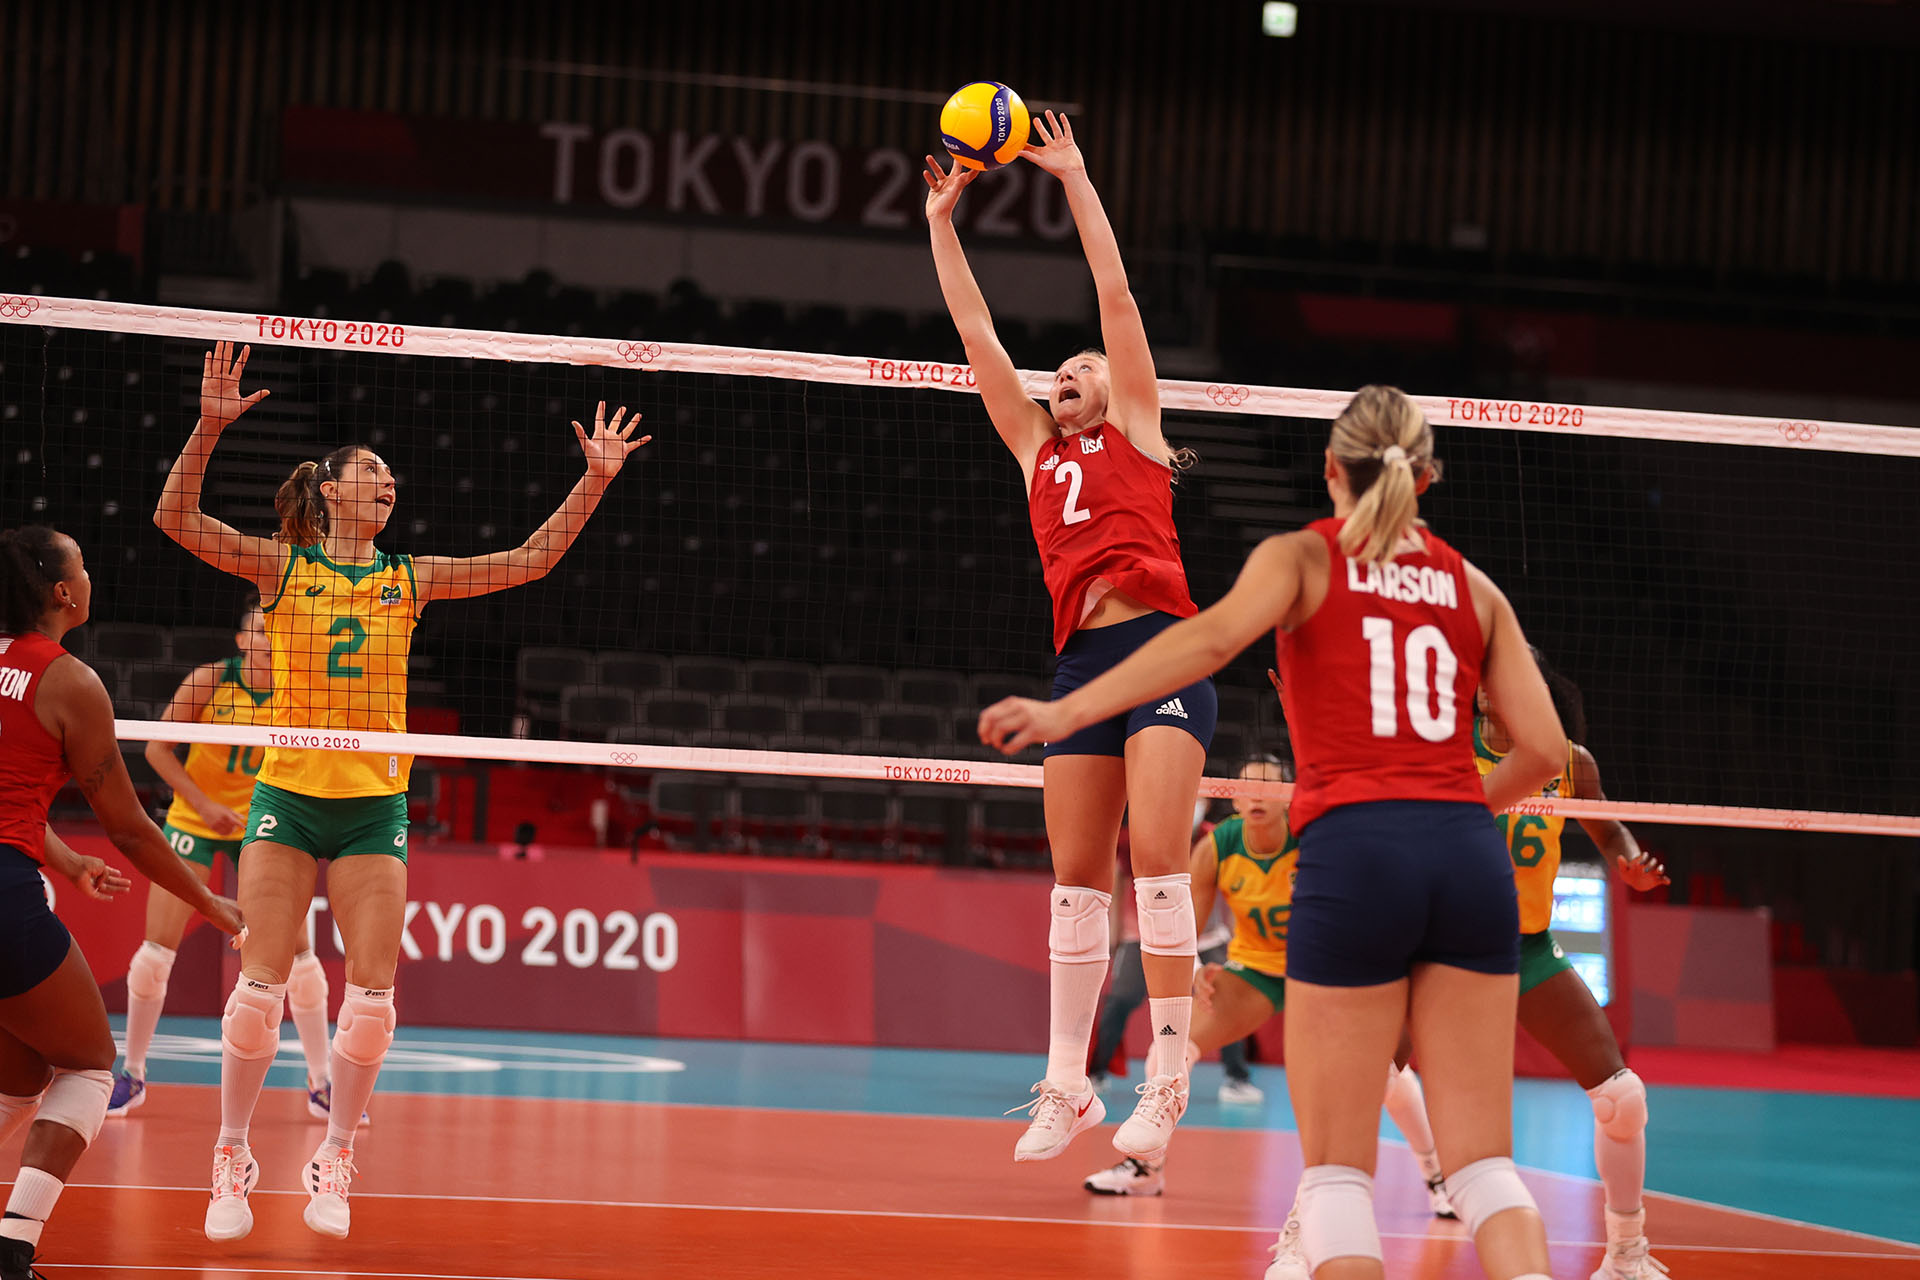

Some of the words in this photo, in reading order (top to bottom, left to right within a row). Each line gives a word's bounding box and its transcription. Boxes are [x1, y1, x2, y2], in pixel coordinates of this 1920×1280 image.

[995, 97, 1005, 116] 2020
[540, 121, 842, 222] TOKYO
[862, 150, 1076, 241] 220
[255, 315, 338, 343] TOKYO
[344, 322, 405, 348] 2020
[867, 359, 944, 383] TOKYO
[950, 366, 977, 387] 20
[1447, 399, 1522, 423] TOKYO
[1528, 404, 1584, 427] 2020
[1080, 439, 1104, 455] USA
[1054, 460, 1091, 526] 2
[1346, 556, 1458, 610] LARSON
[327, 616, 367, 678] 2
[1362, 616, 1458, 742] 10
[269, 733, 320, 747] TOKYO
[323, 737, 360, 749] 2020
[884, 765, 931, 780] TOKYO
[935, 767, 970, 782] 2020
[255, 814, 279, 837] 2
[170, 831, 195, 856] 10
[306, 896, 507, 964] TKYO
[521, 905, 680, 972] 2020
